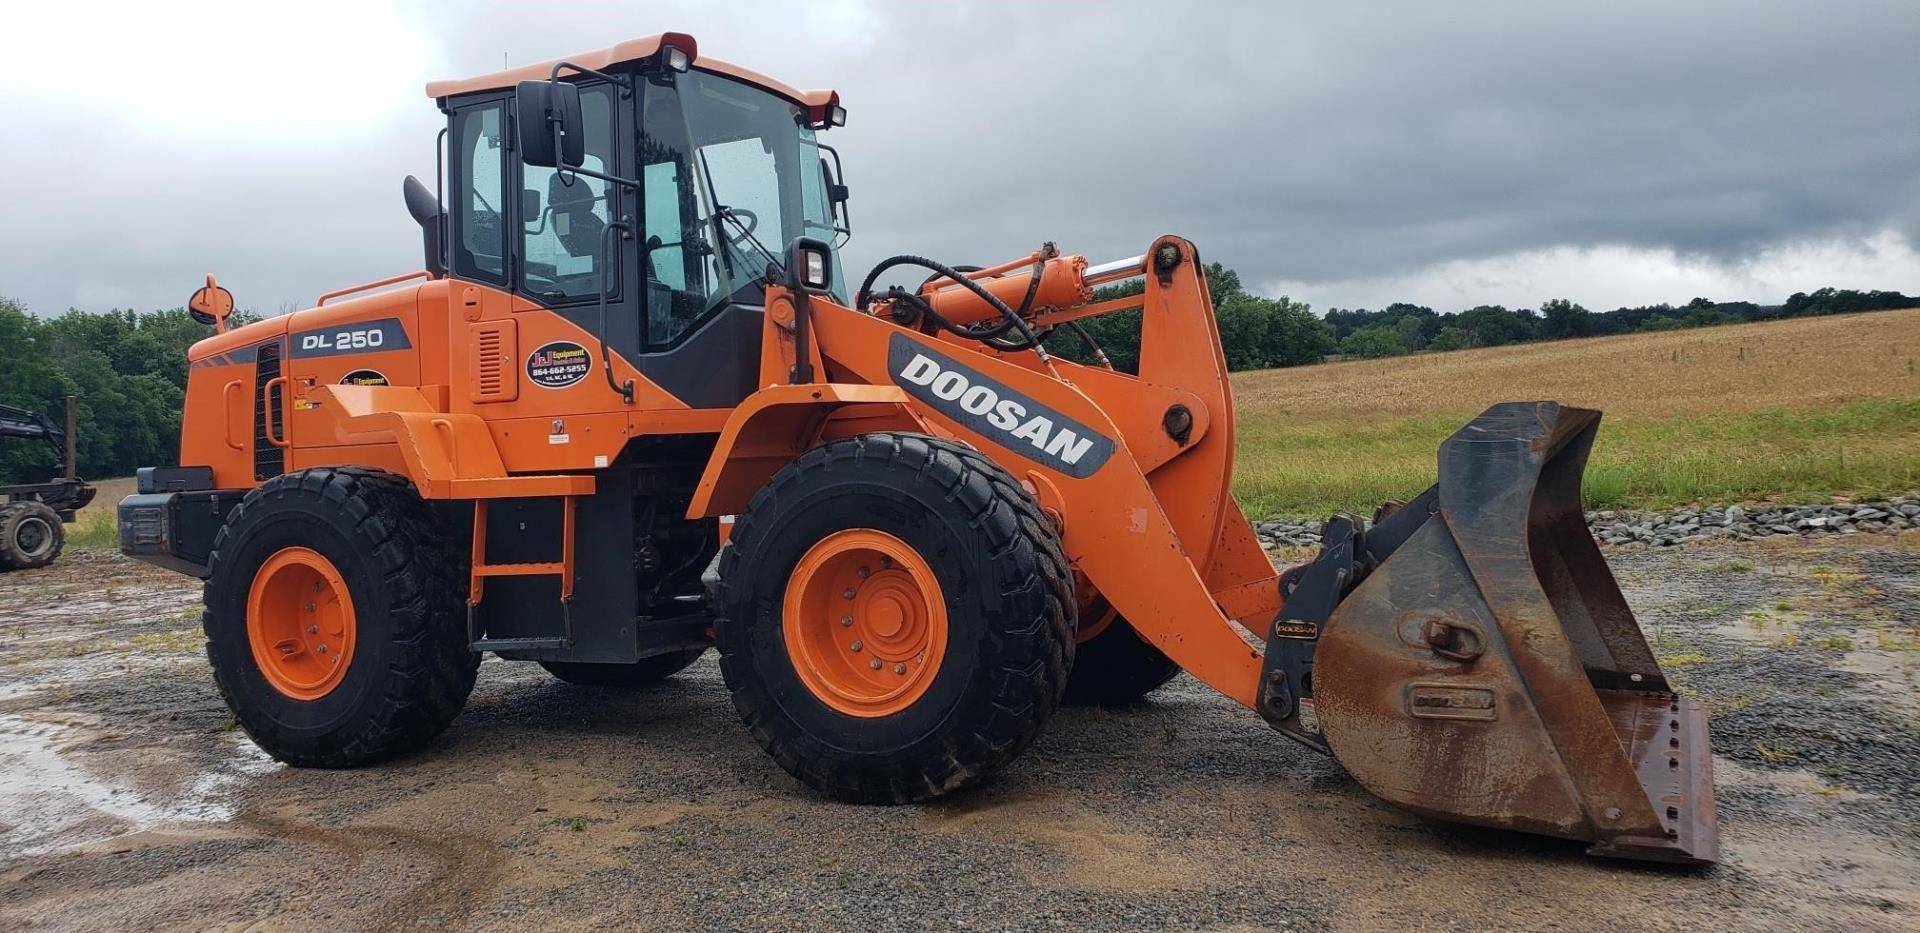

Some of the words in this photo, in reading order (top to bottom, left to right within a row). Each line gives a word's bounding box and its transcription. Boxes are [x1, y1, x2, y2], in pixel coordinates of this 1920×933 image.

[302, 335, 332, 349] DL
[336, 329, 383, 350] 250
[553, 350, 584, 359] Equipment
[533, 364, 586, 376] 864-662-5255
[900, 353, 1093, 465] DOOSAN
